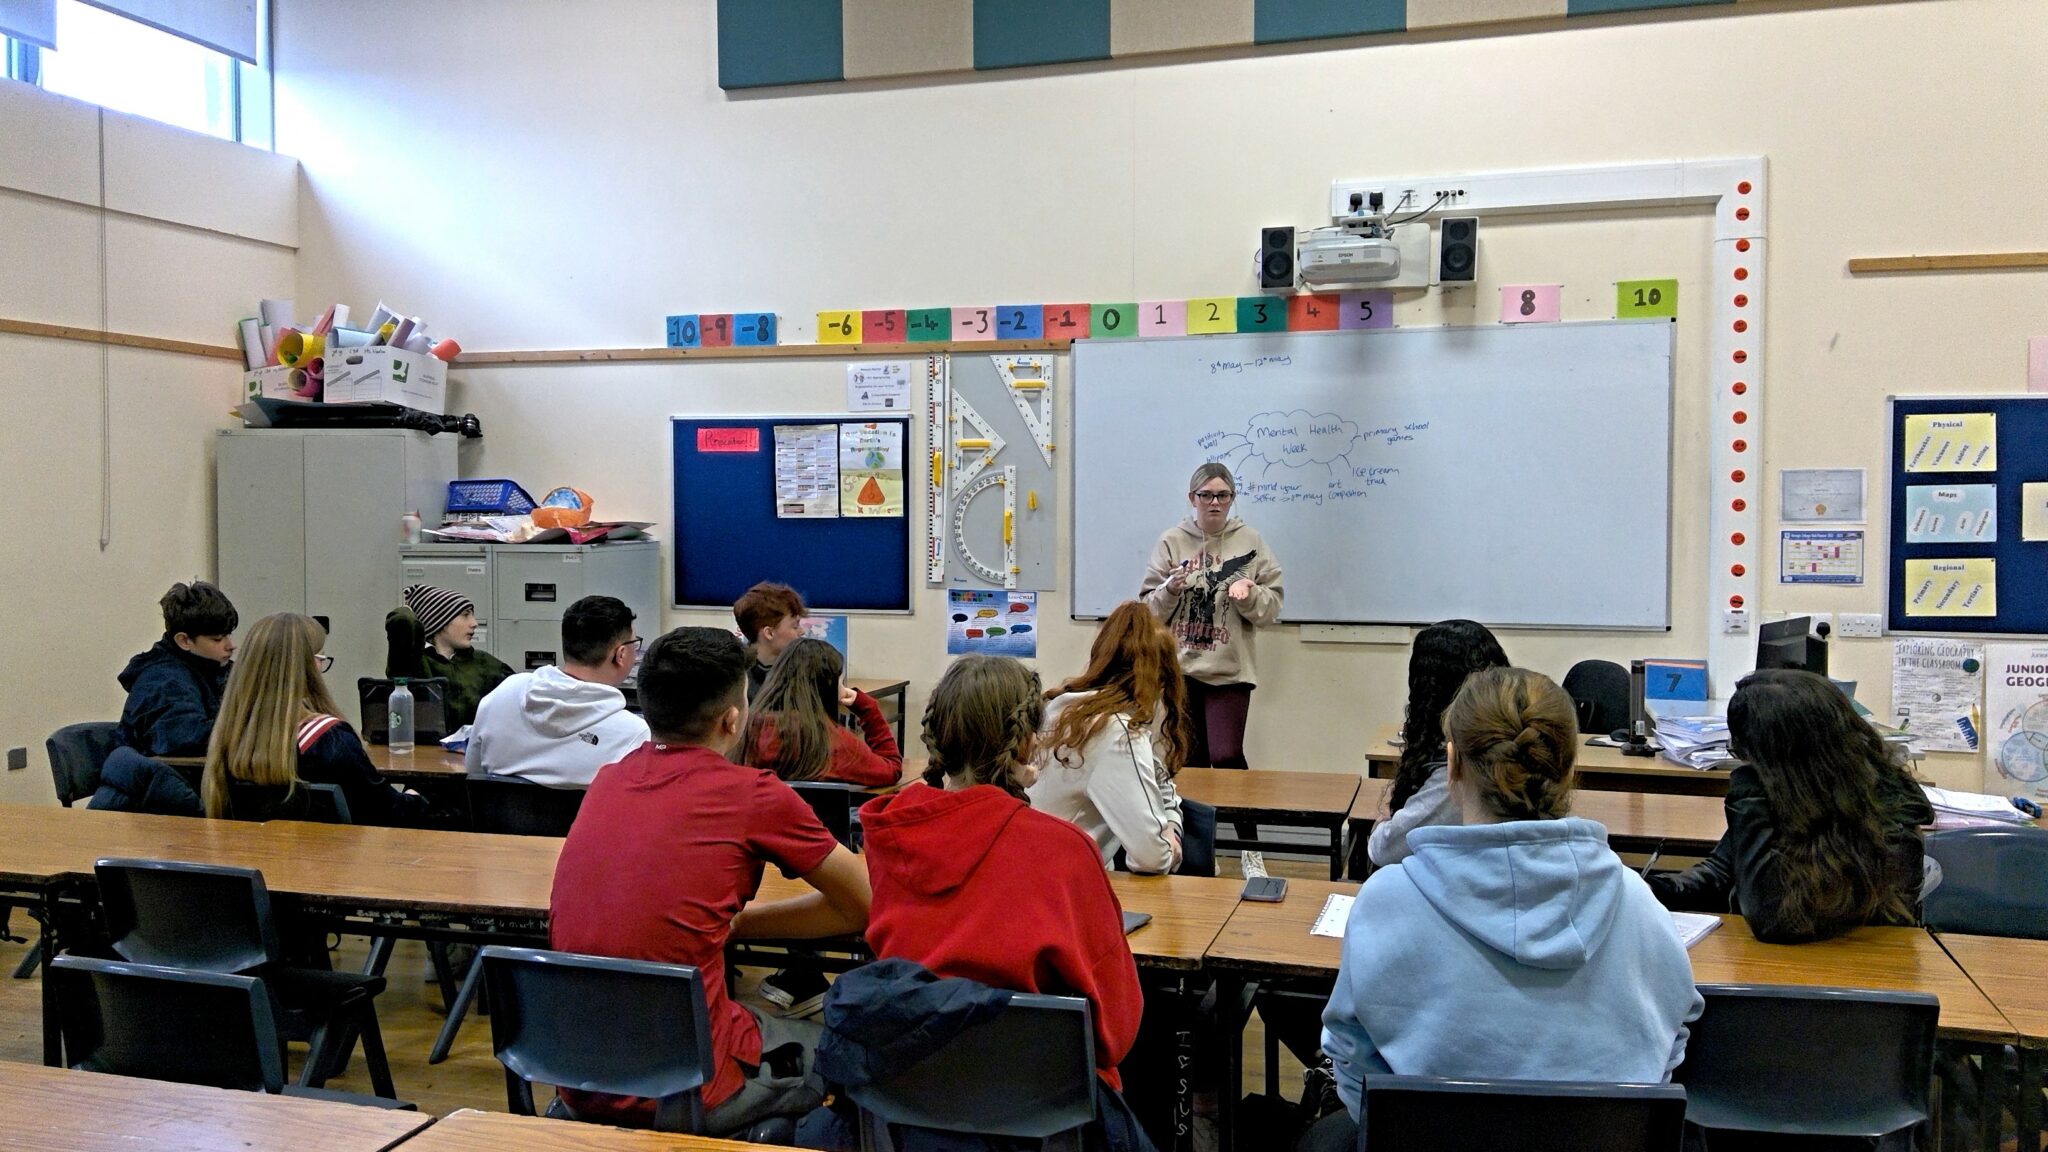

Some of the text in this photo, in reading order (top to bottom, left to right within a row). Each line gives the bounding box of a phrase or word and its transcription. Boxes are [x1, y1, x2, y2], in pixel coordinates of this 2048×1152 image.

[1520, 289, 1536, 316] 8
[1633, 287, 1662, 307] 10
[828, 300, 1373, 336] -6 -5 -4 -3 -2 -1 0 1 2 3 4 5
[669, 315, 770, 347] -10 -9 -8
[1257, 423, 1343, 438] Mental Health
[1363, 421, 1430, 441] primary school
[1932, 421, 1963, 429] Physical
[1909, 436, 1932, 468] Earthquakes
[1913, 580, 1933, 604] Primary
[1936, 580, 1961, 610] Secondary
[1962, 584, 1983, 608] Tertiary
[1922, 658, 1961, 670] CLASSROOM
[1666, 673, 1682, 693] 7
[2006, 676, 2048, 687] GEOG
